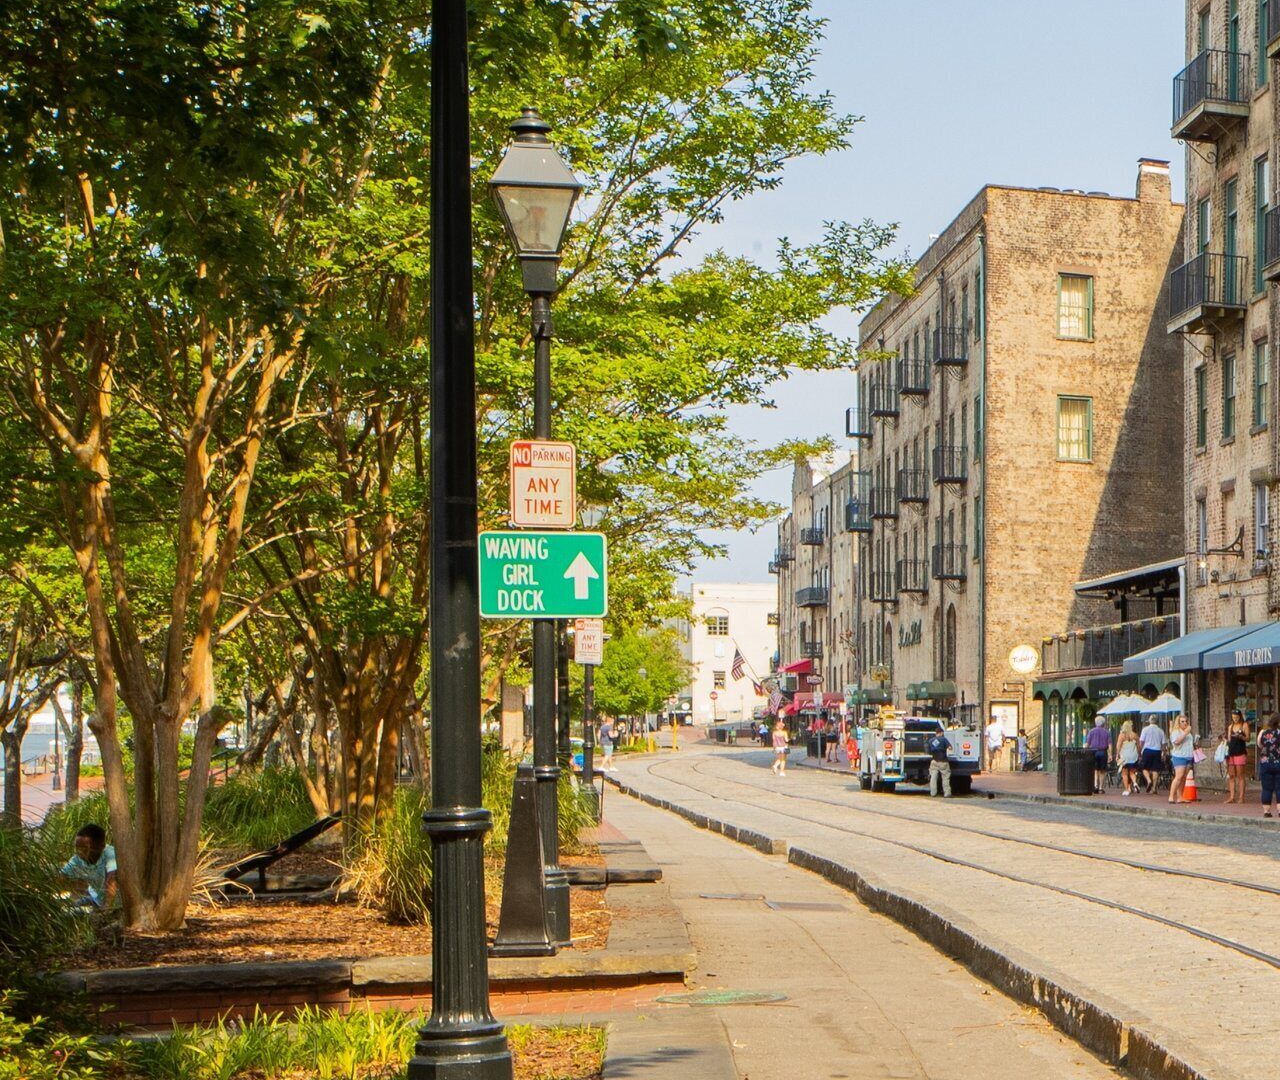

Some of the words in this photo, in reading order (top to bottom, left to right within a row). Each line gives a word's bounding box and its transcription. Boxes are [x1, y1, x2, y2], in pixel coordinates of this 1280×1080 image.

[514, 447, 530, 464] NO
[533, 450, 571, 462] PARKING
[527, 477, 560, 493] ANY
[524, 498, 563, 515] TIME
[484, 537, 549, 559] WAVING
[503, 564, 539, 585] GIRL
[497, 589, 546, 611] DOCK
[1235, 650, 1251, 667] TRUE
[1251, 647, 1272, 664] GRITS
